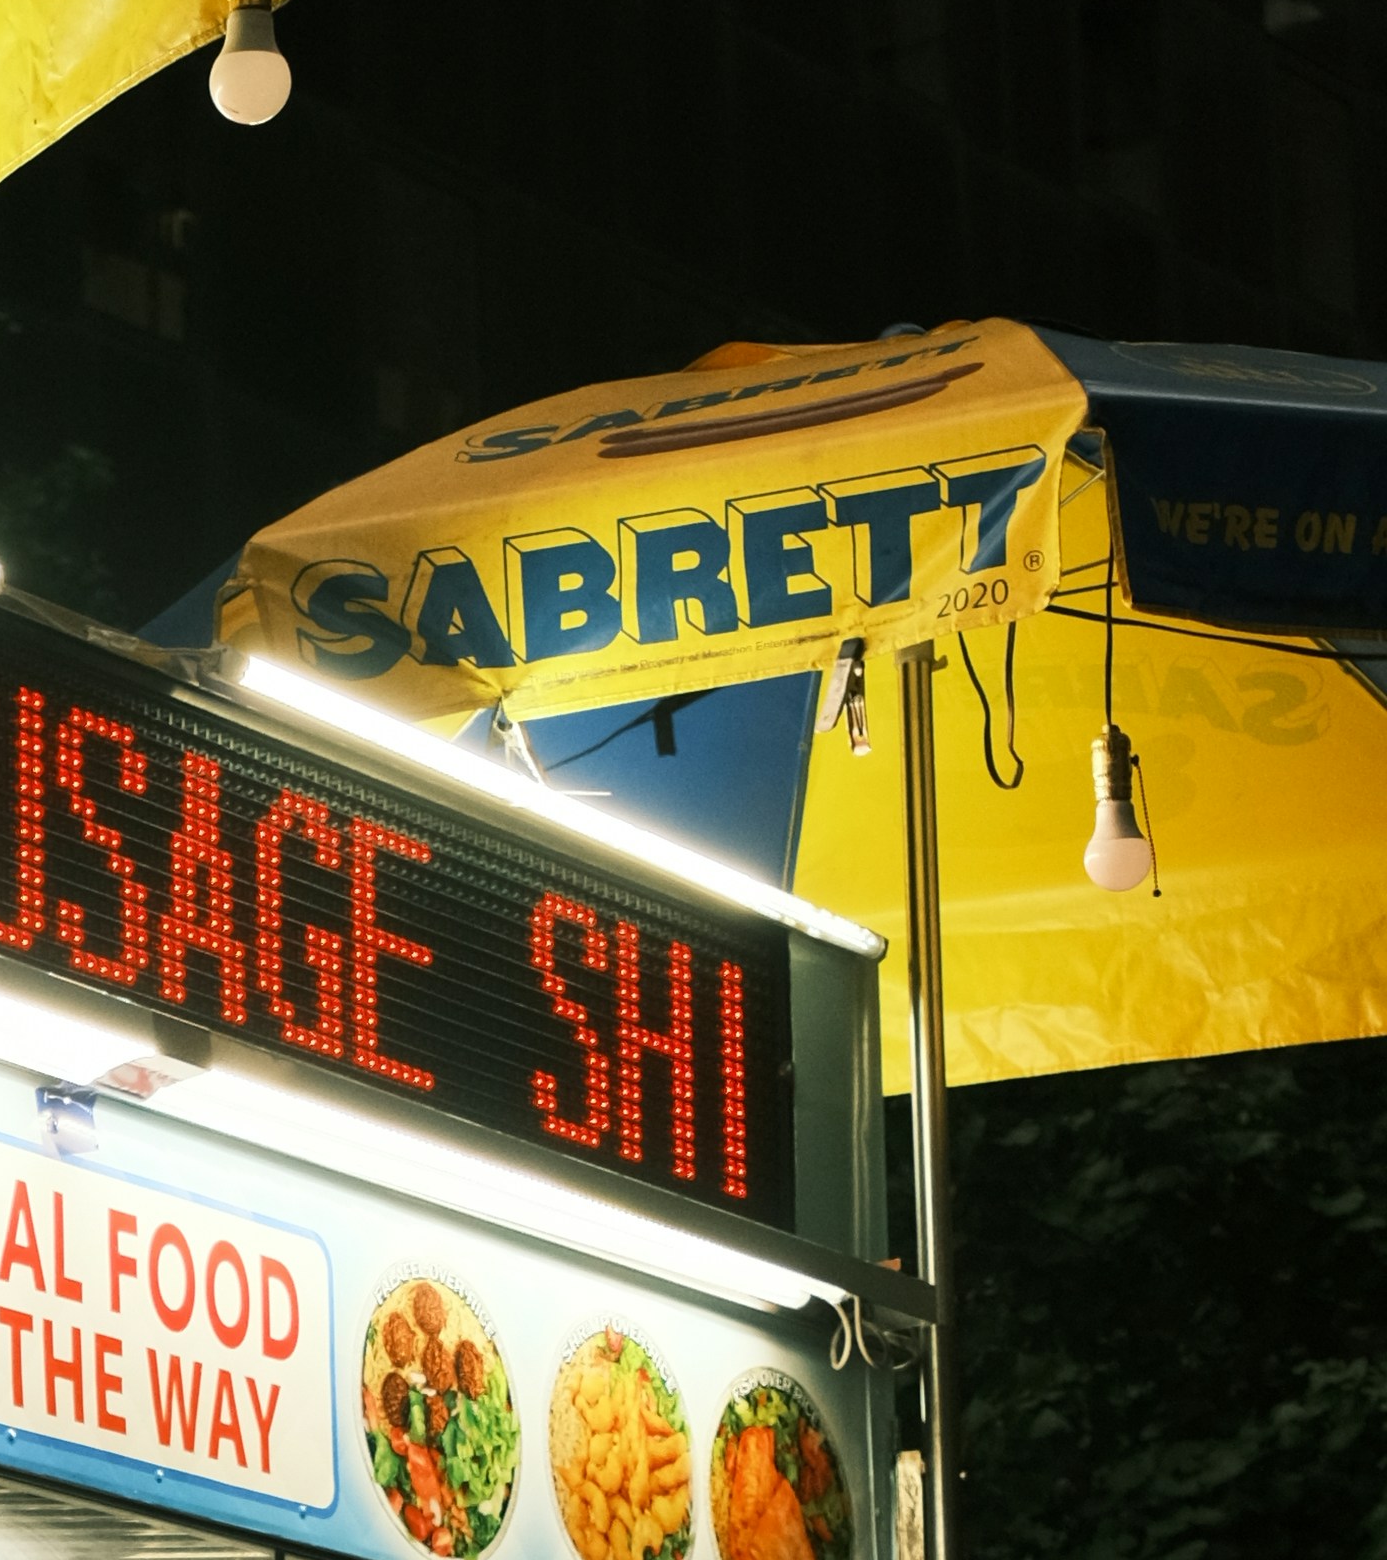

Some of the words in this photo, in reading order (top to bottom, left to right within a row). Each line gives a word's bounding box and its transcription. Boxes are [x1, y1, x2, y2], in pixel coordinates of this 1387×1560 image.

[455, 336, 981, 462] SABRETT
[293, 446, 1045, 682] SABRETT
[1150, 495, 1279, 552] WE'RE
[1296, 510, 1357, 554] ON
[936, 579, 1009, 619] 2020
[531, 890, 747, 1200] SHI
[109, 1208, 299, 1361] FOOD
[147, 1347, 280, 1476] WAY
